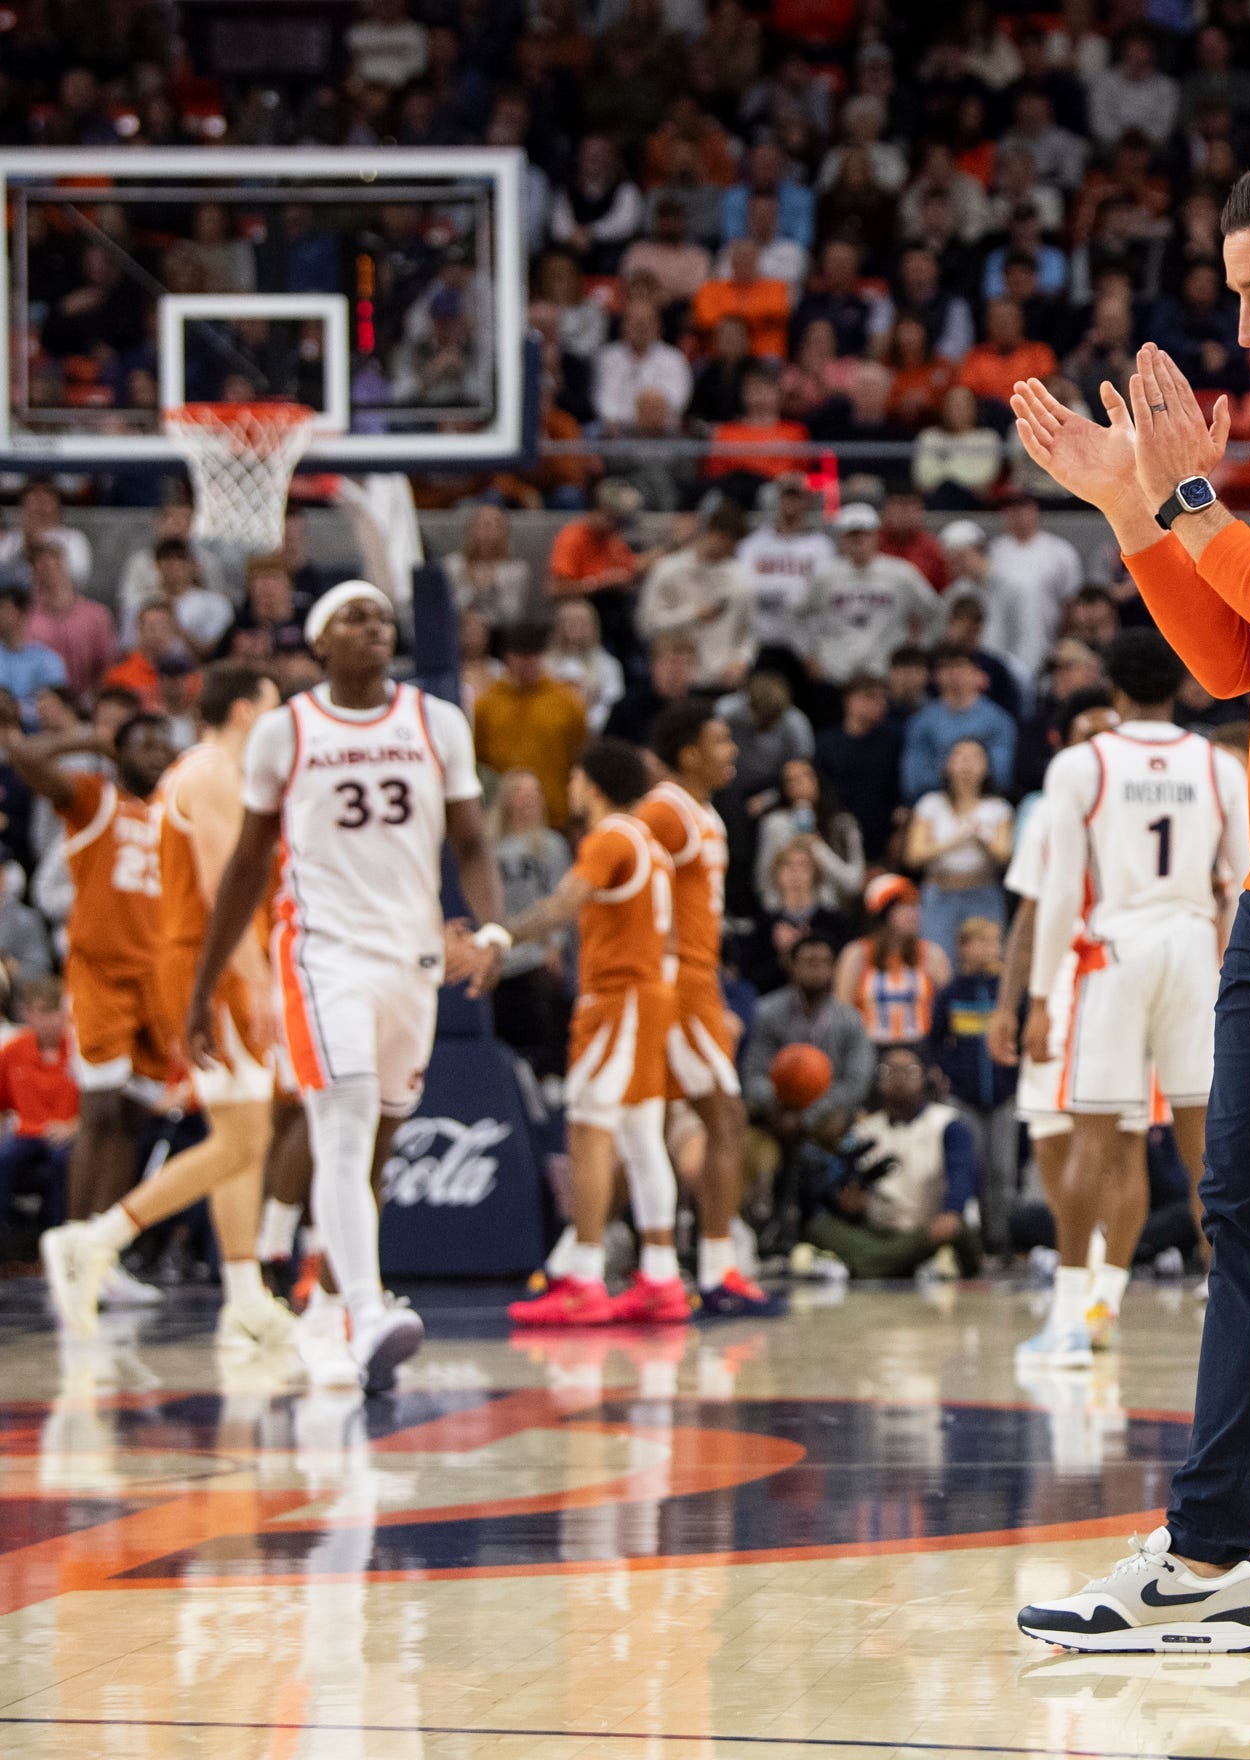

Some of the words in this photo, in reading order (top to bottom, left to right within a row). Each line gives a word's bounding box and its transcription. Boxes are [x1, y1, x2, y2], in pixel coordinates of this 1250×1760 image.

[307, 749, 424, 769] AUBURN
[334, 779, 413, 829] 33
[1124, 781, 1197, 803] OVERTON
[1148, 814, 1171, 877] 1
